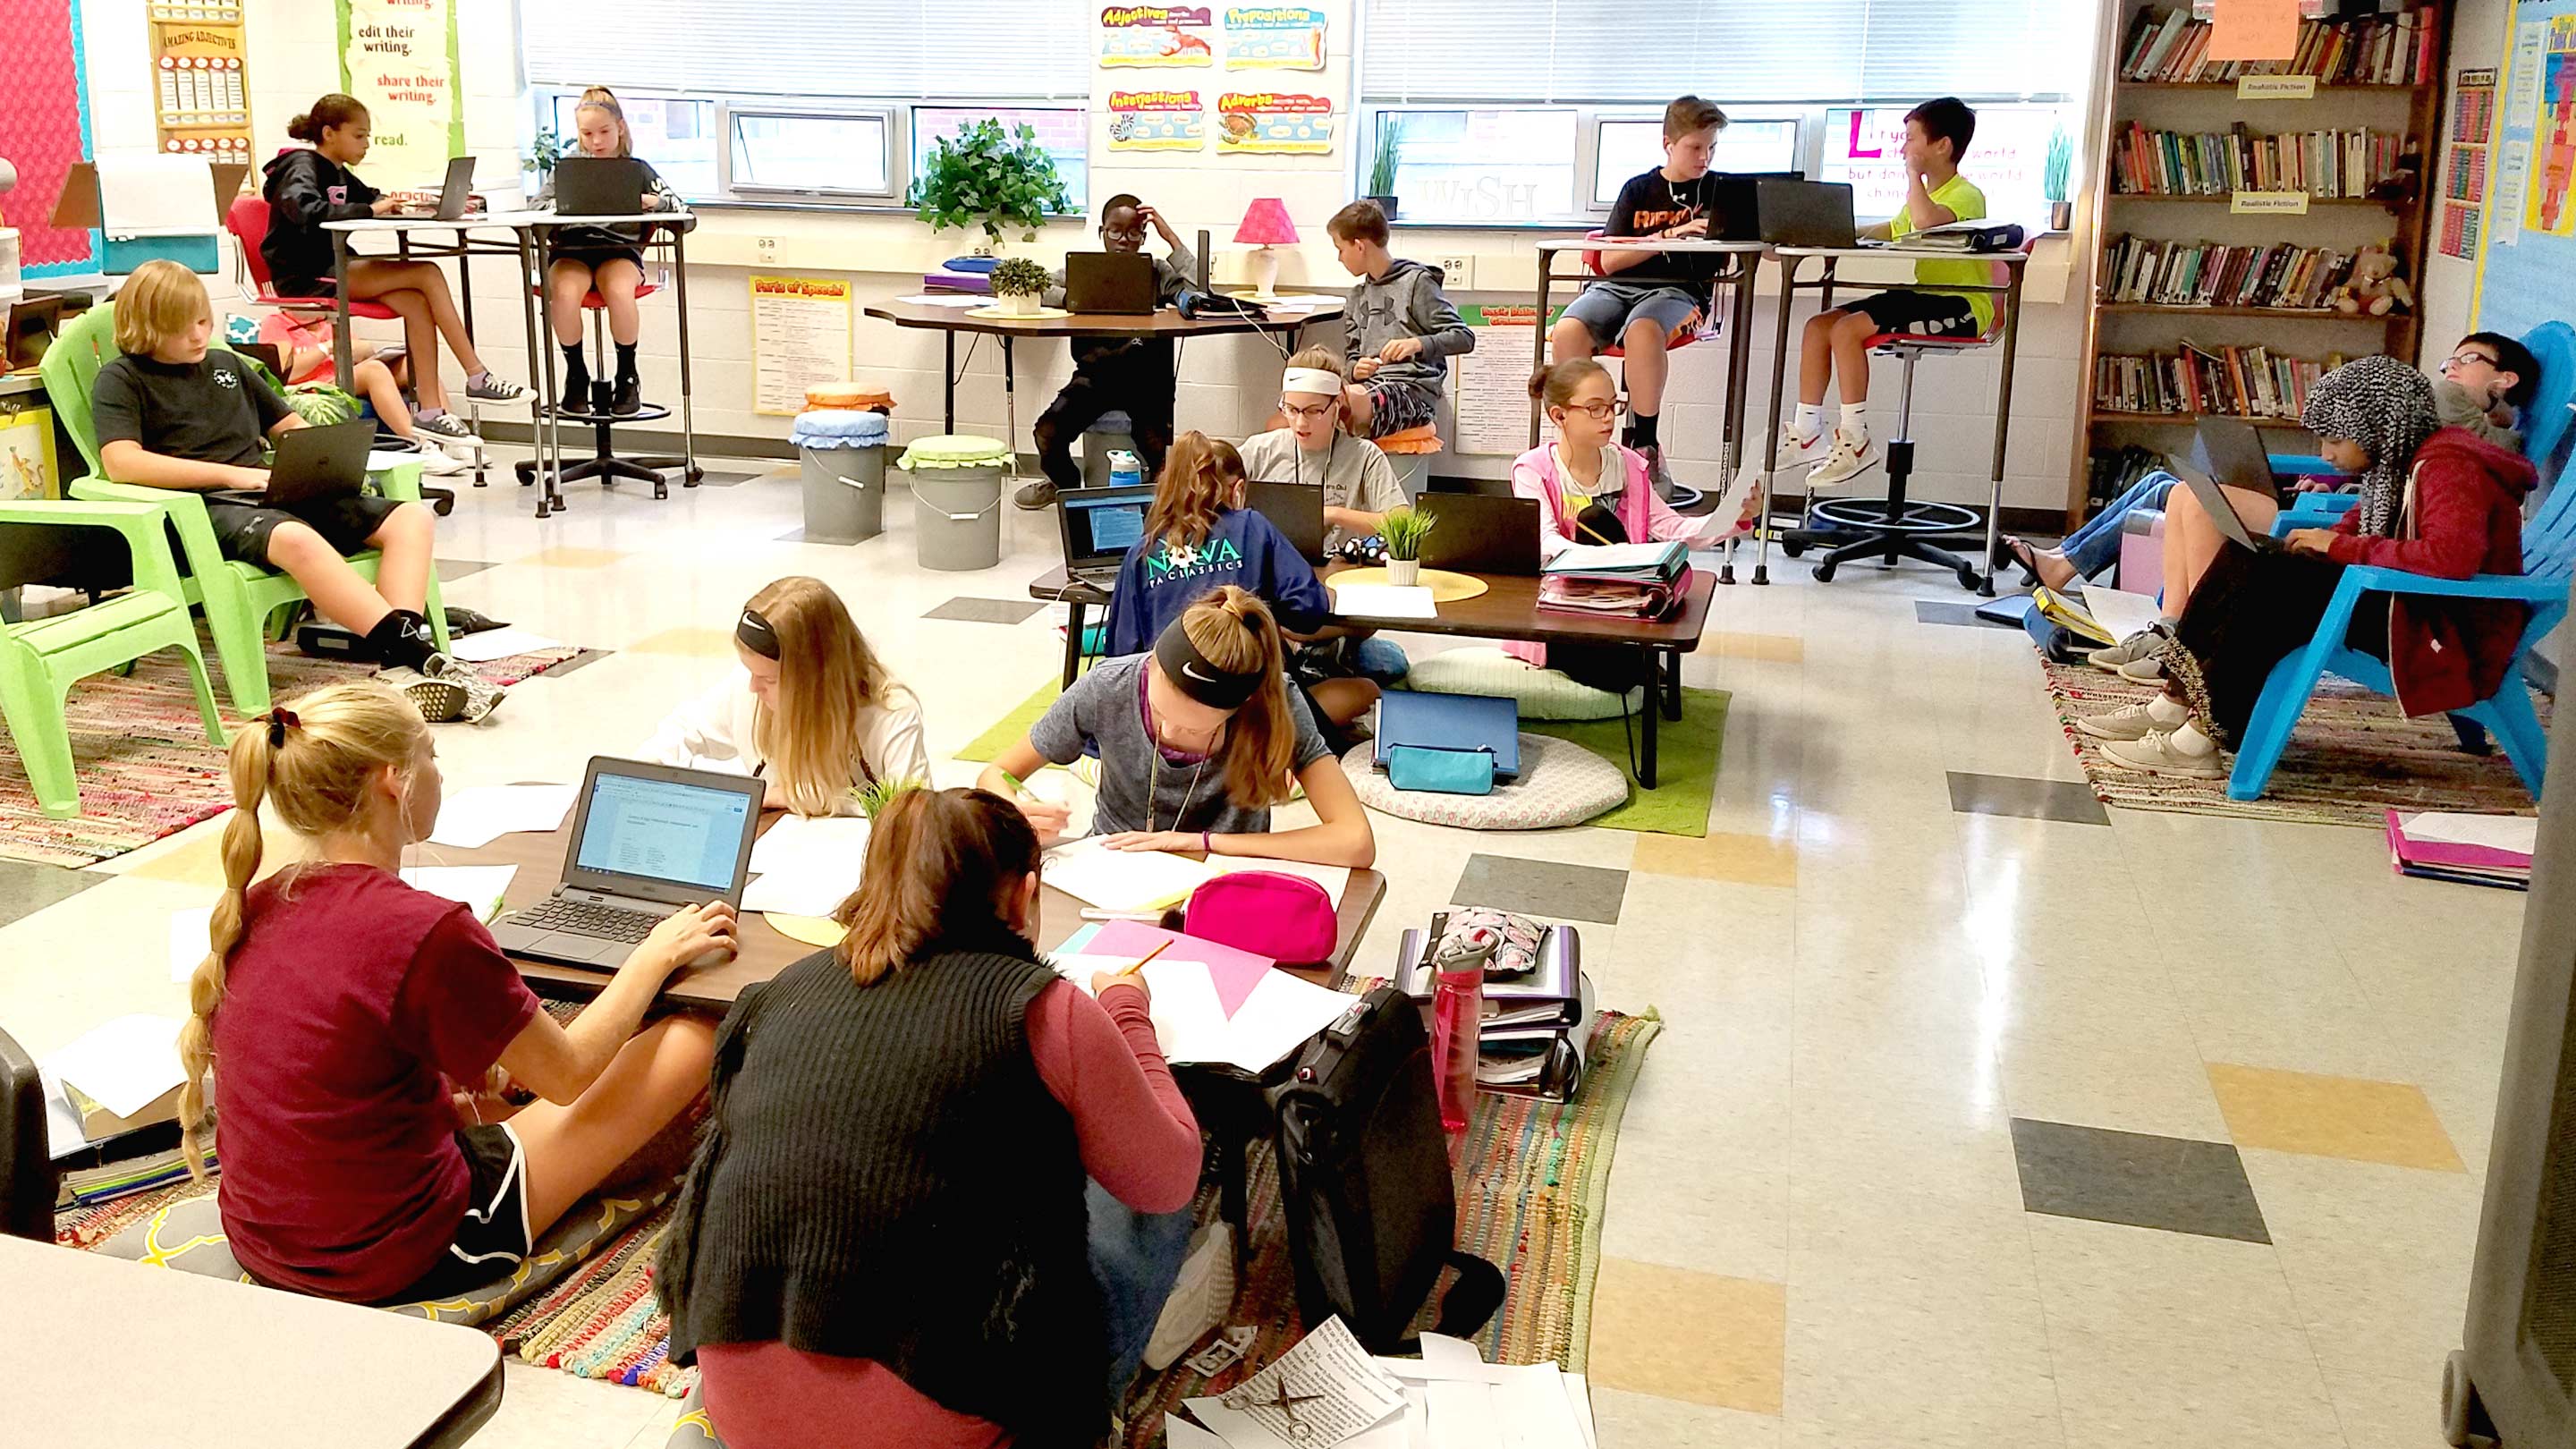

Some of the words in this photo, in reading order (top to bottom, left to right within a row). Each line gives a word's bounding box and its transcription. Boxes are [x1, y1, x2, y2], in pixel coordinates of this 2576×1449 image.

[359, 25, 381, 38] edit
[386, 25, 415, 38] their
[164, 31, 195, 48] AMAZING
[196, 30, 236, 49] ADJECTIVES
[363, 40, 412, 56] writing.
[377, 73, 411, 87] share
[416, 75, 445, 87] their
[388, 90, 437, 106] writing.
[1220, 93, 1274, 112] Adverbs
[374, 133, 408, 146] read.
[1971, 146, 2016, 159] world
[1849, 167, 1872, 180] but
[755, 279, 785, 293] Parts
[787, 280, 801, 293] of
[1168, 559, 1243, 580] CLASSICS
